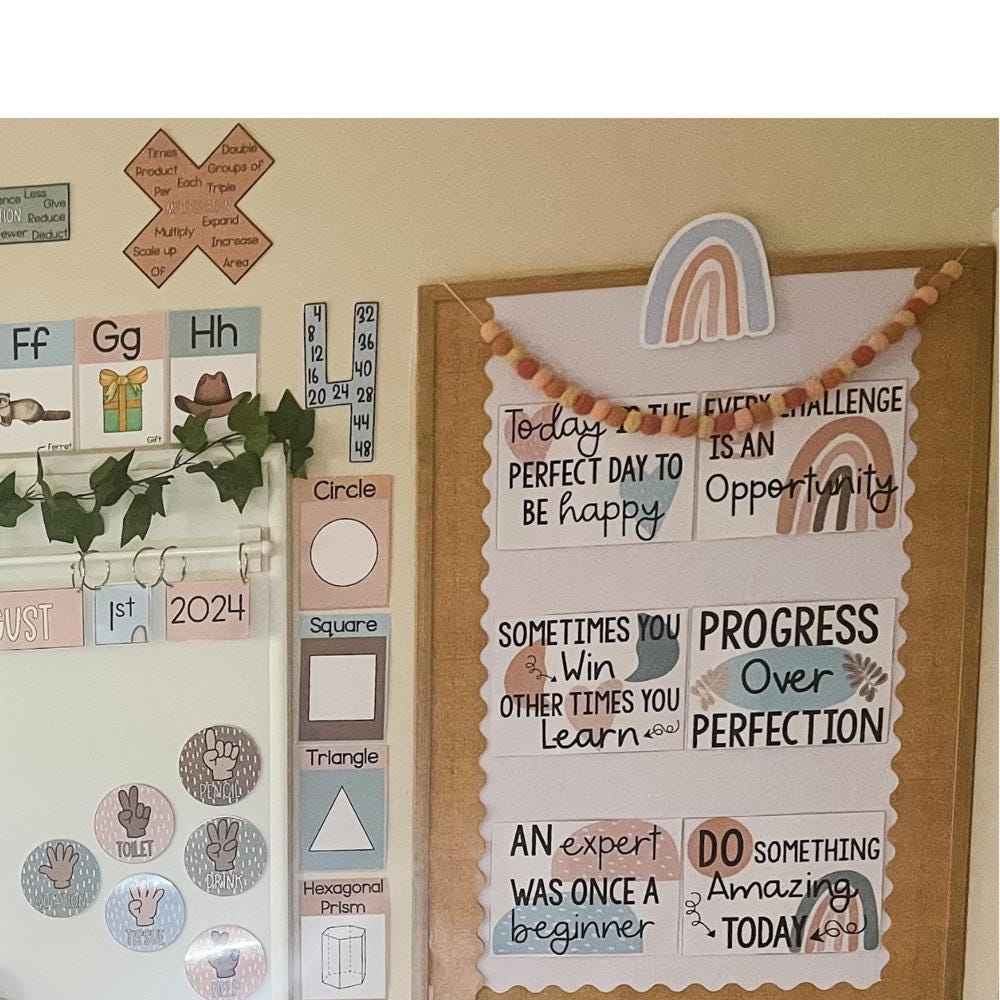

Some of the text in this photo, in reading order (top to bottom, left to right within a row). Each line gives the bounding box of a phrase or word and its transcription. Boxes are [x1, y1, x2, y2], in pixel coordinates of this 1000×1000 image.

[222, 144, 258, 155] Double
[135, 166, 177, 178] Product
[208, 162, 246, 175] Groups
[27, 212, 65, 224] Reduce
[154, 226, 195, 240] Multiply
[202, 214, 238, 227] Expand
[32, 229, 68, 240] Deduct
[211, 235, 258, 248] Increase
[357, 307, 374, 322] 32
[13, 327, 51, 361] Ff
[93, 321, 141, 360] Gg
[192, 315, 238, 350] Hh
[332, 384, 349, 399] 24
[505, 404, 607, 457] Today
[710, 431, 774, 460] IS AN
[509, 453, 682, 489] PERFECT DAY TO
[314, 480, 376, 500] Circle
[706, 464, 898, 516] Opportunity
[523, 491, 665, 541] BE happy
[109, 596, 135, 630] 1st
[170, 594, 246, 625] 2024
[310, 617, 377, 635] Square
[499, 614, 680, 647] SOMETIMES YOU
[700, 604, 879, 650] PROGRESS
[561, 650, 615, 681] Win
[742, 658, 833, 694] Over
[500, 688, 679, 718] OTHER TIMES YOU
[542, 719, 640, 749] Learn
[693, 708, 884, 748] PERFECTION
[306, 749, 379, 767] Triangle
[116, 840, 153, 858] TOILET
[510, 824, 661, 869] AN expert
[699, 829, 880, 867] DO SOMETHING
[207, 873, 243, 890] DRINK
[303, 880, 384, 897] Hexagonal
[510, 877, 659, 906] WAS ONCE A
[708, 871, 858, 912] Amazing
[321, 900, 365, 915] Prism
[511, 909, 655, 955] beginner
[722, 915, 807, 948] TODAY
